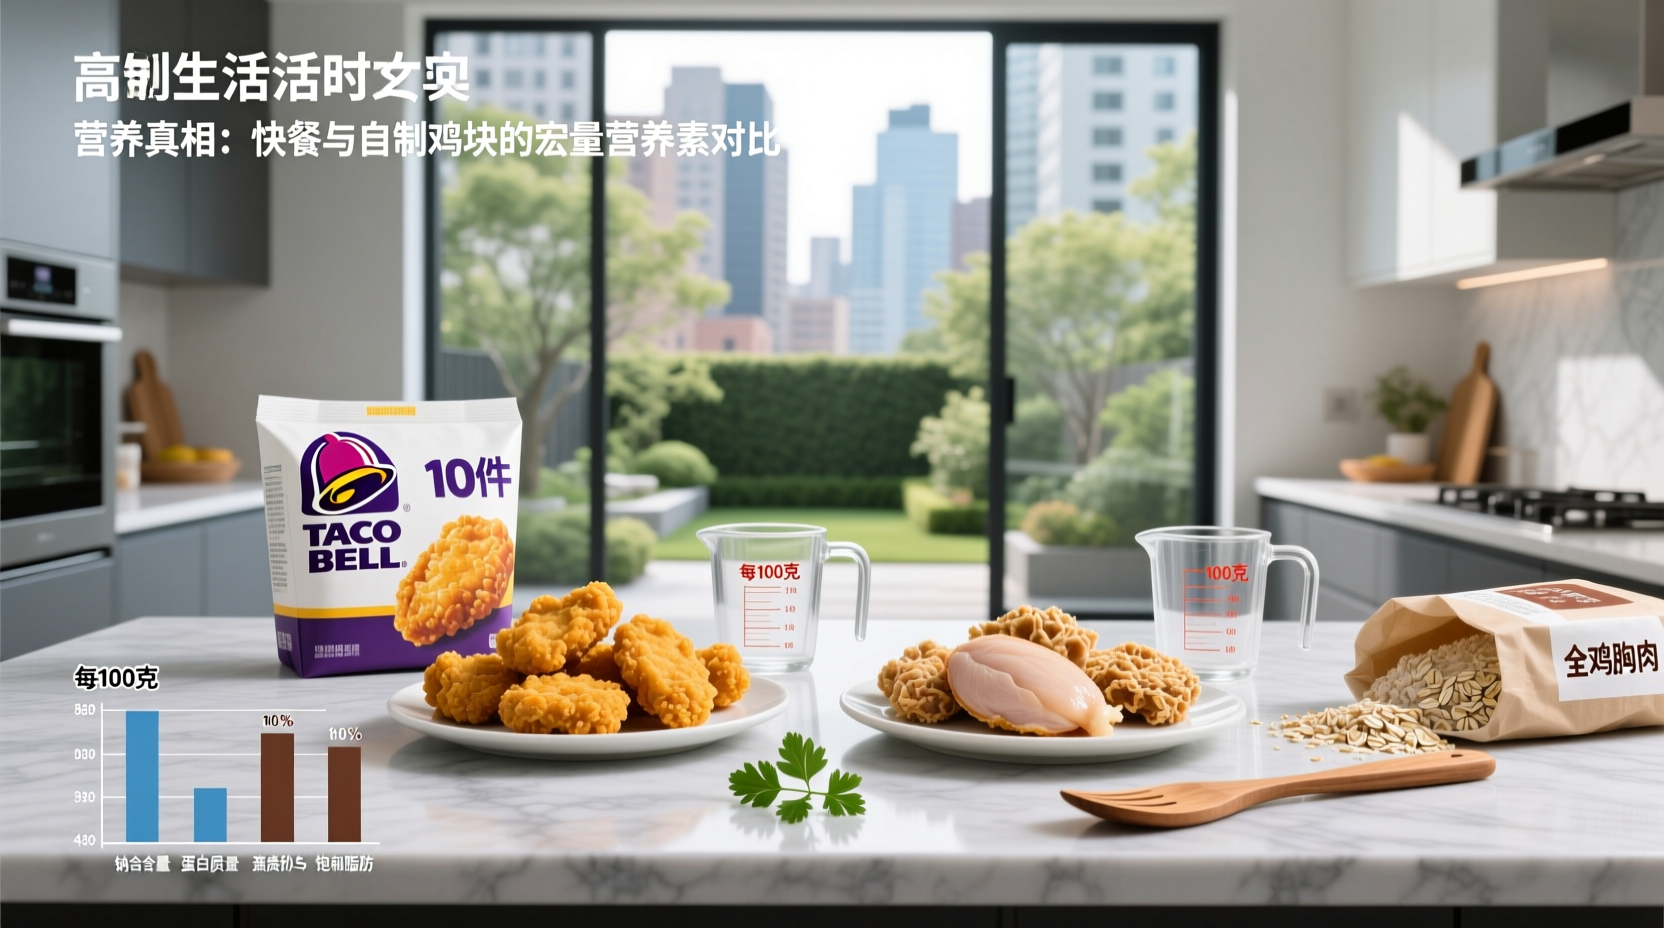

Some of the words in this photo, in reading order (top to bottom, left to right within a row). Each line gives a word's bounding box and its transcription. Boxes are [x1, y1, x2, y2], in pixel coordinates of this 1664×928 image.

[424, 455, 512, 498] 10件
[303, 519, 402, 547] TACO
[308, 546, 401, 574] BELL
[739, 562, 801, 581] 每100克
[1205, 563, 1249, 582] 100克
[1564, 639, 1659, 678] 全鸡胸肉
